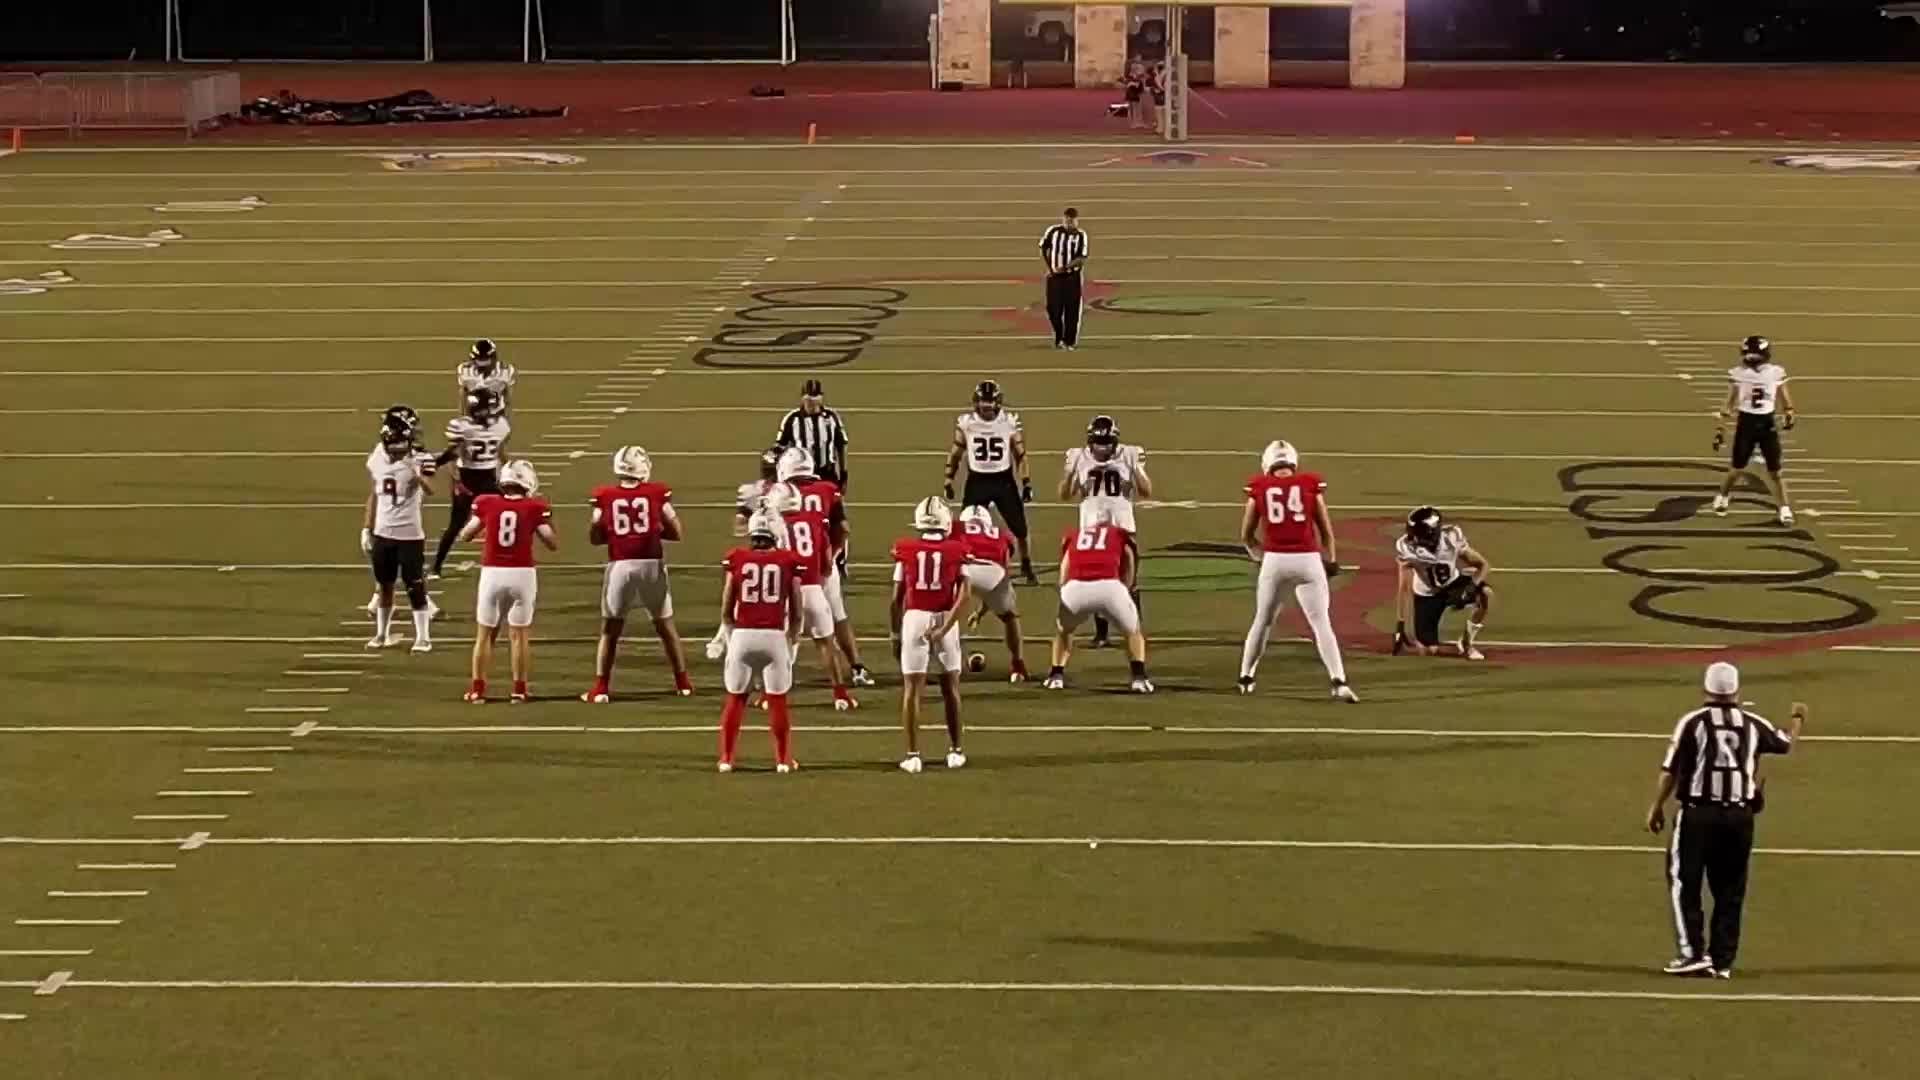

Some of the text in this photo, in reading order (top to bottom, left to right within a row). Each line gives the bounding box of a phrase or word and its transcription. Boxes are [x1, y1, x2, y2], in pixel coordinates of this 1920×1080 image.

[692, 286, 908, 369] CCISD
[1751, 387, 1765, 409] 2
[973, 436, 1004, 461] 35
[383, 477, 398, 506] 9
[1265, 485, 1306, 523] 64
[498, 510, 517, 547] 8
[612, 497, 650, 535] 63
[1076, 527, 1109, 551] 61
[1557, 461, 1878, 634] CCISD
[741, 562, 781, 604] 20
[915, 550, 942, 591] 11
[1714, 729, 1741, 768] R
